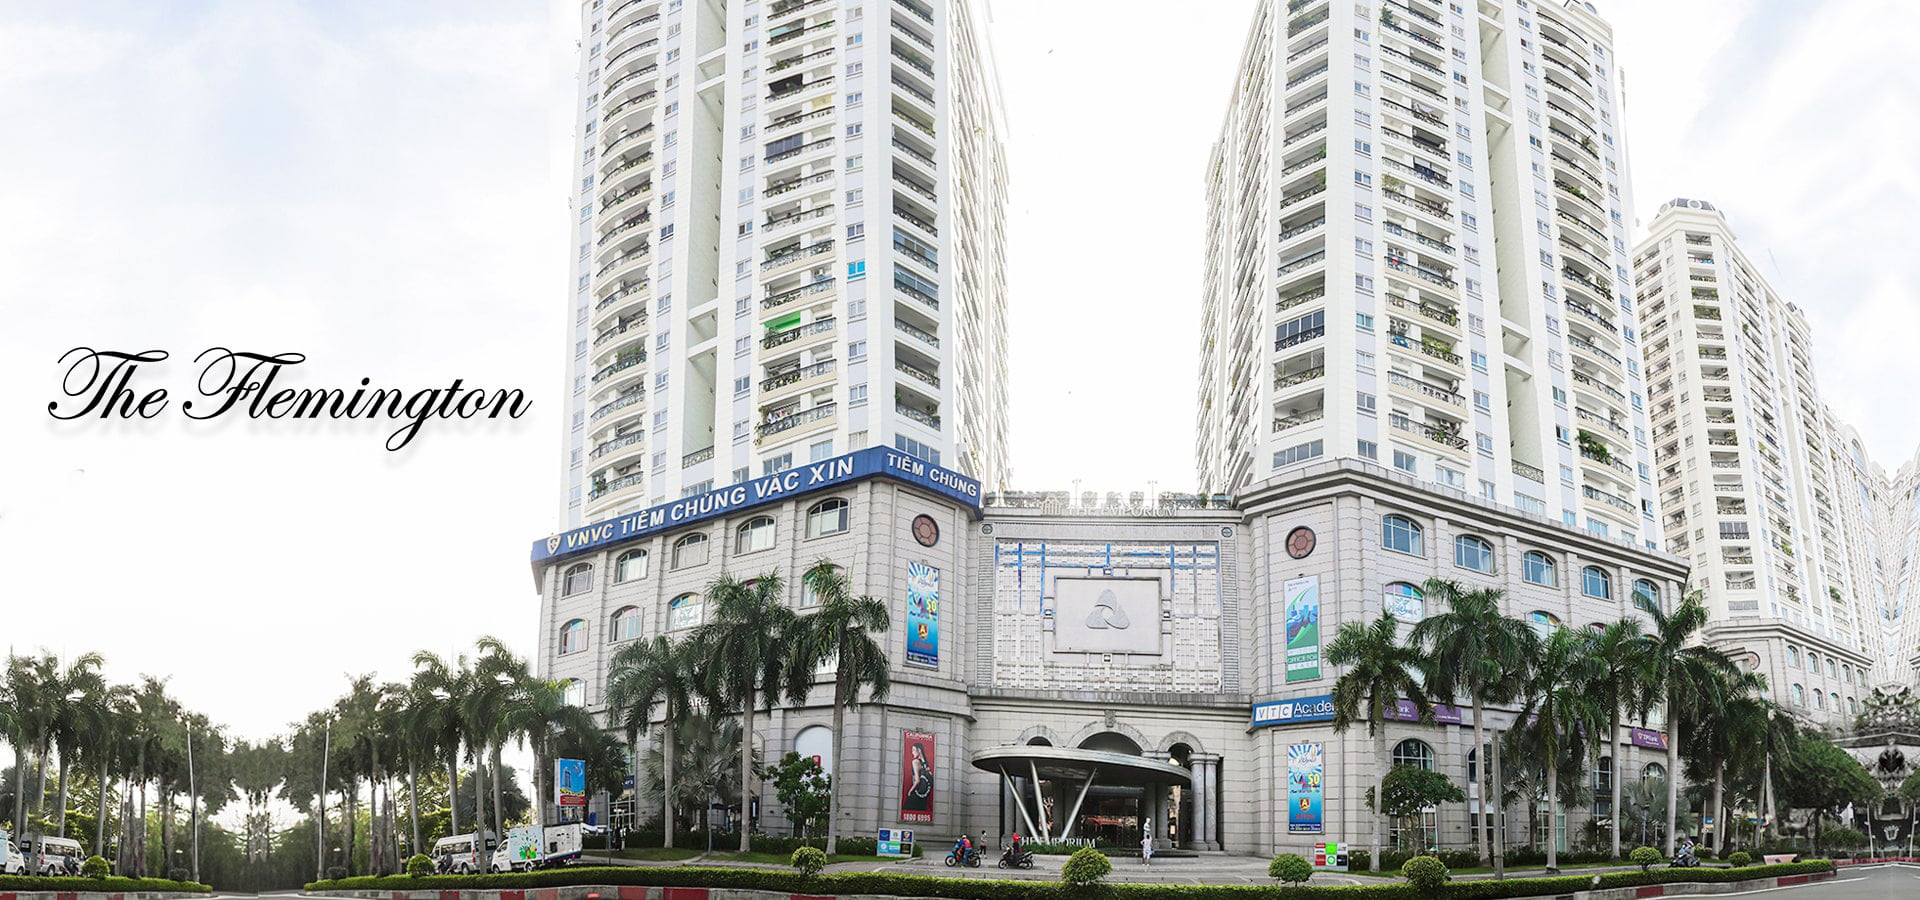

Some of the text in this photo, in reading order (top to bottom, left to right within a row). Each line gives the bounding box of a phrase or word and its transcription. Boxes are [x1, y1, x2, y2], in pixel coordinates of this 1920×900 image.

[887, 453, 977, 497] TIÊM CHỦNG
[567, 456, 854, 549] VNVC TIÊM CHỦNG VẮC XIN
[1101, 503, 1178, 518] EMPORIUM
[1258, 700, 1335, 719] VTC Acade
